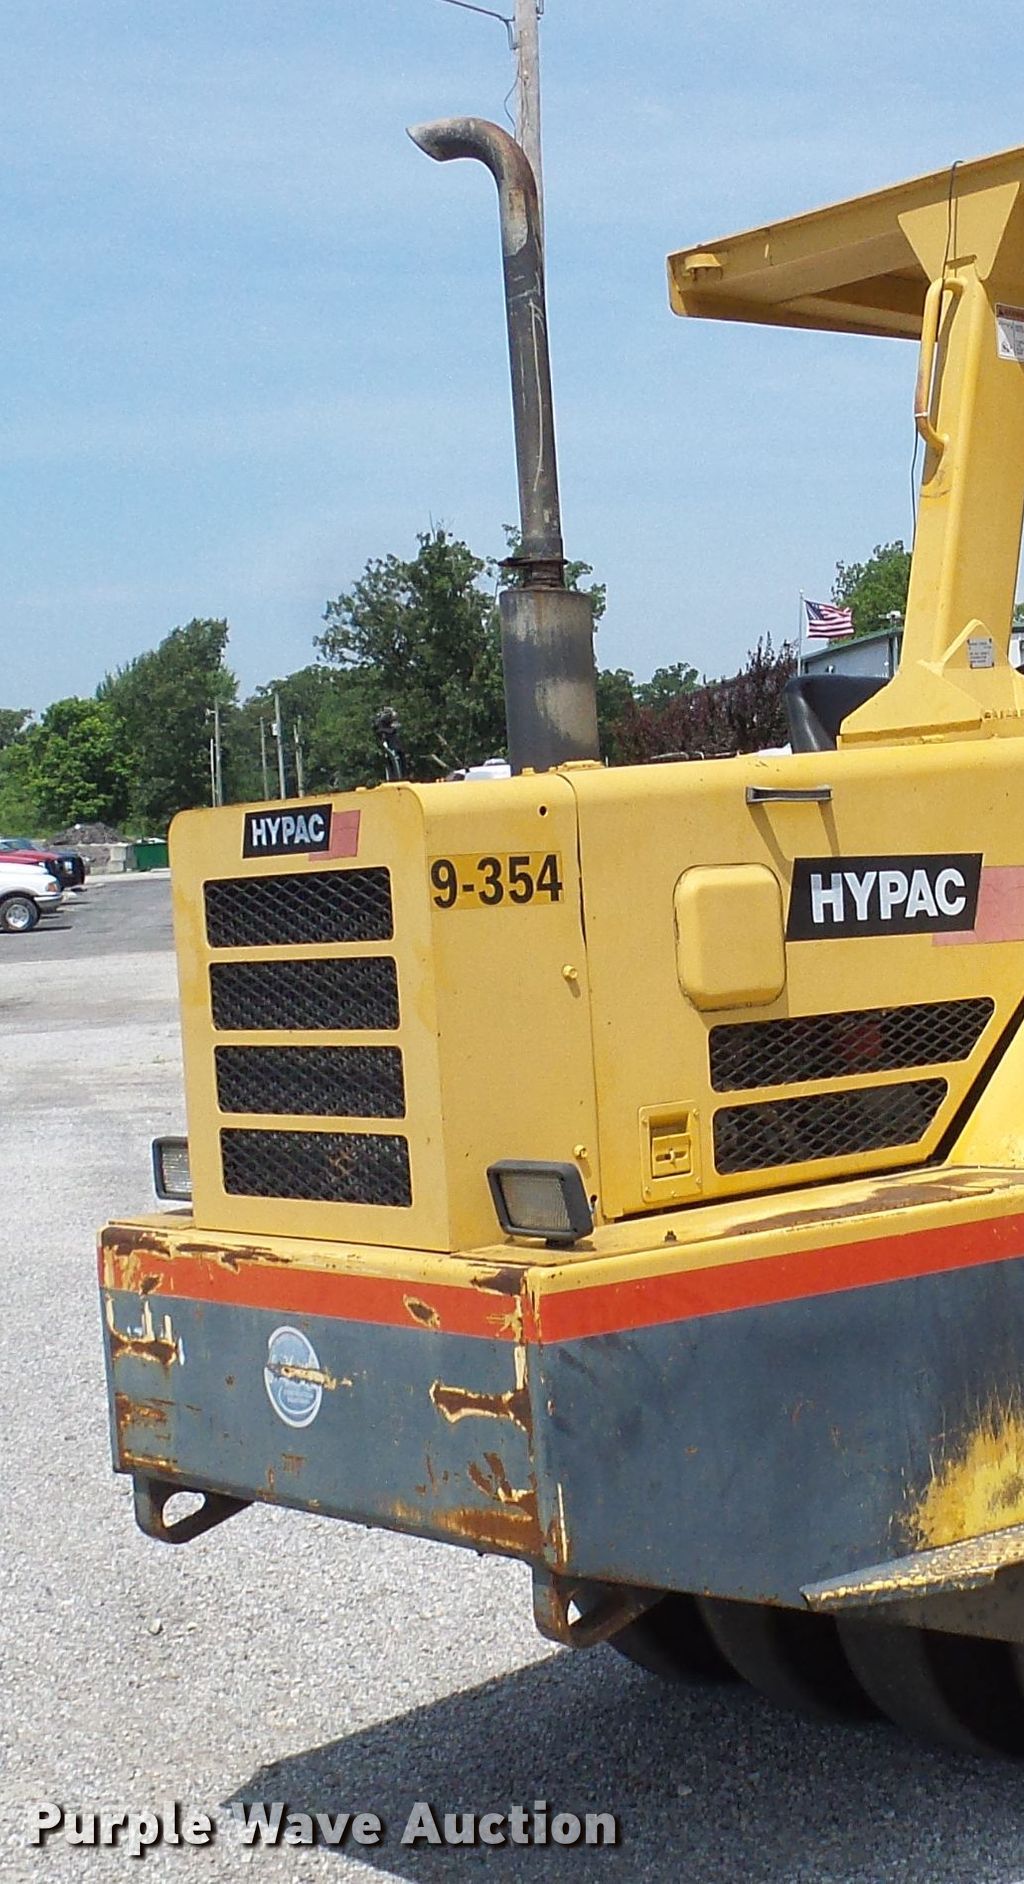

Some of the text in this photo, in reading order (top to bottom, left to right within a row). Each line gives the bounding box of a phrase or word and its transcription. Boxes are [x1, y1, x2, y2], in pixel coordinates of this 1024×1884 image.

[251, 813, 325, 847] HYPAC
[430, 853, 563, 909] 9-354
[810, 868, 966, 923] HYPAC
